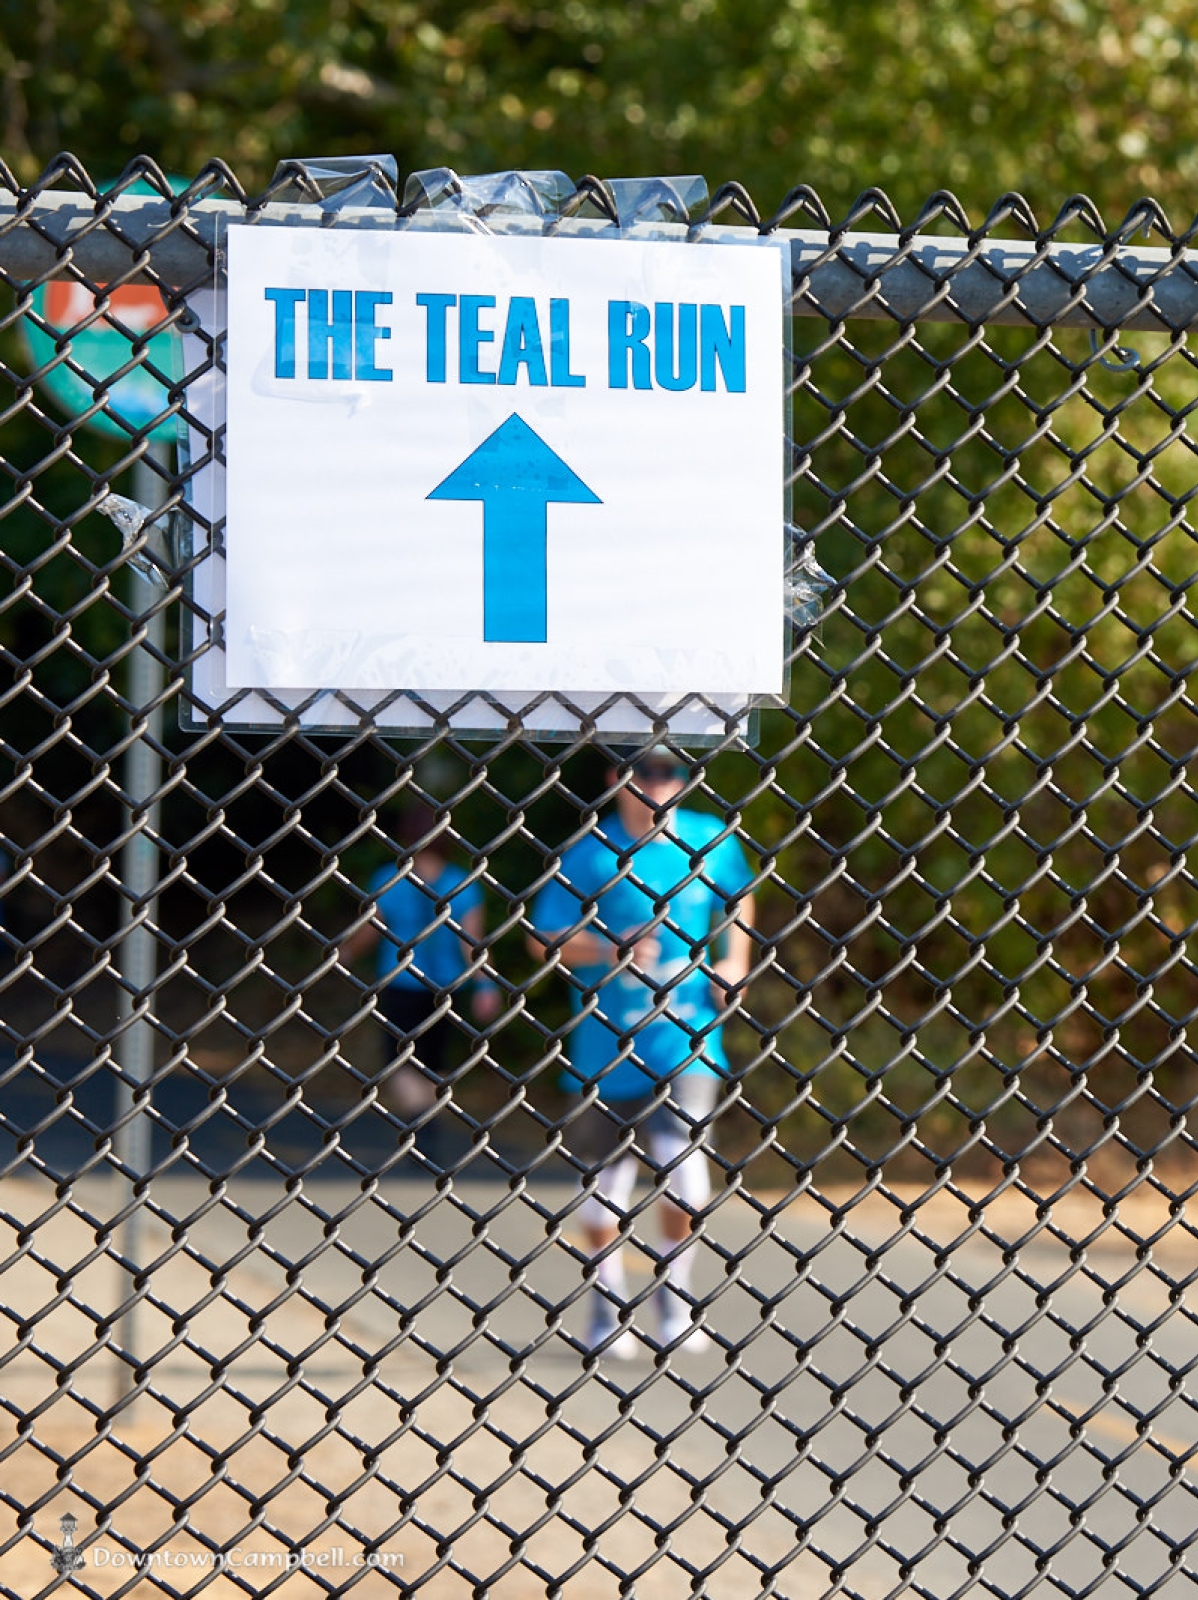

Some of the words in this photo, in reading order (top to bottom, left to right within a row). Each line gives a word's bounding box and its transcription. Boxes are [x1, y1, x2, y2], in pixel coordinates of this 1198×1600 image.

[264, 287, 393, 383] THE
[415, 293, 586, 388] TEAL
[607, 299, 747, 394] RUN
